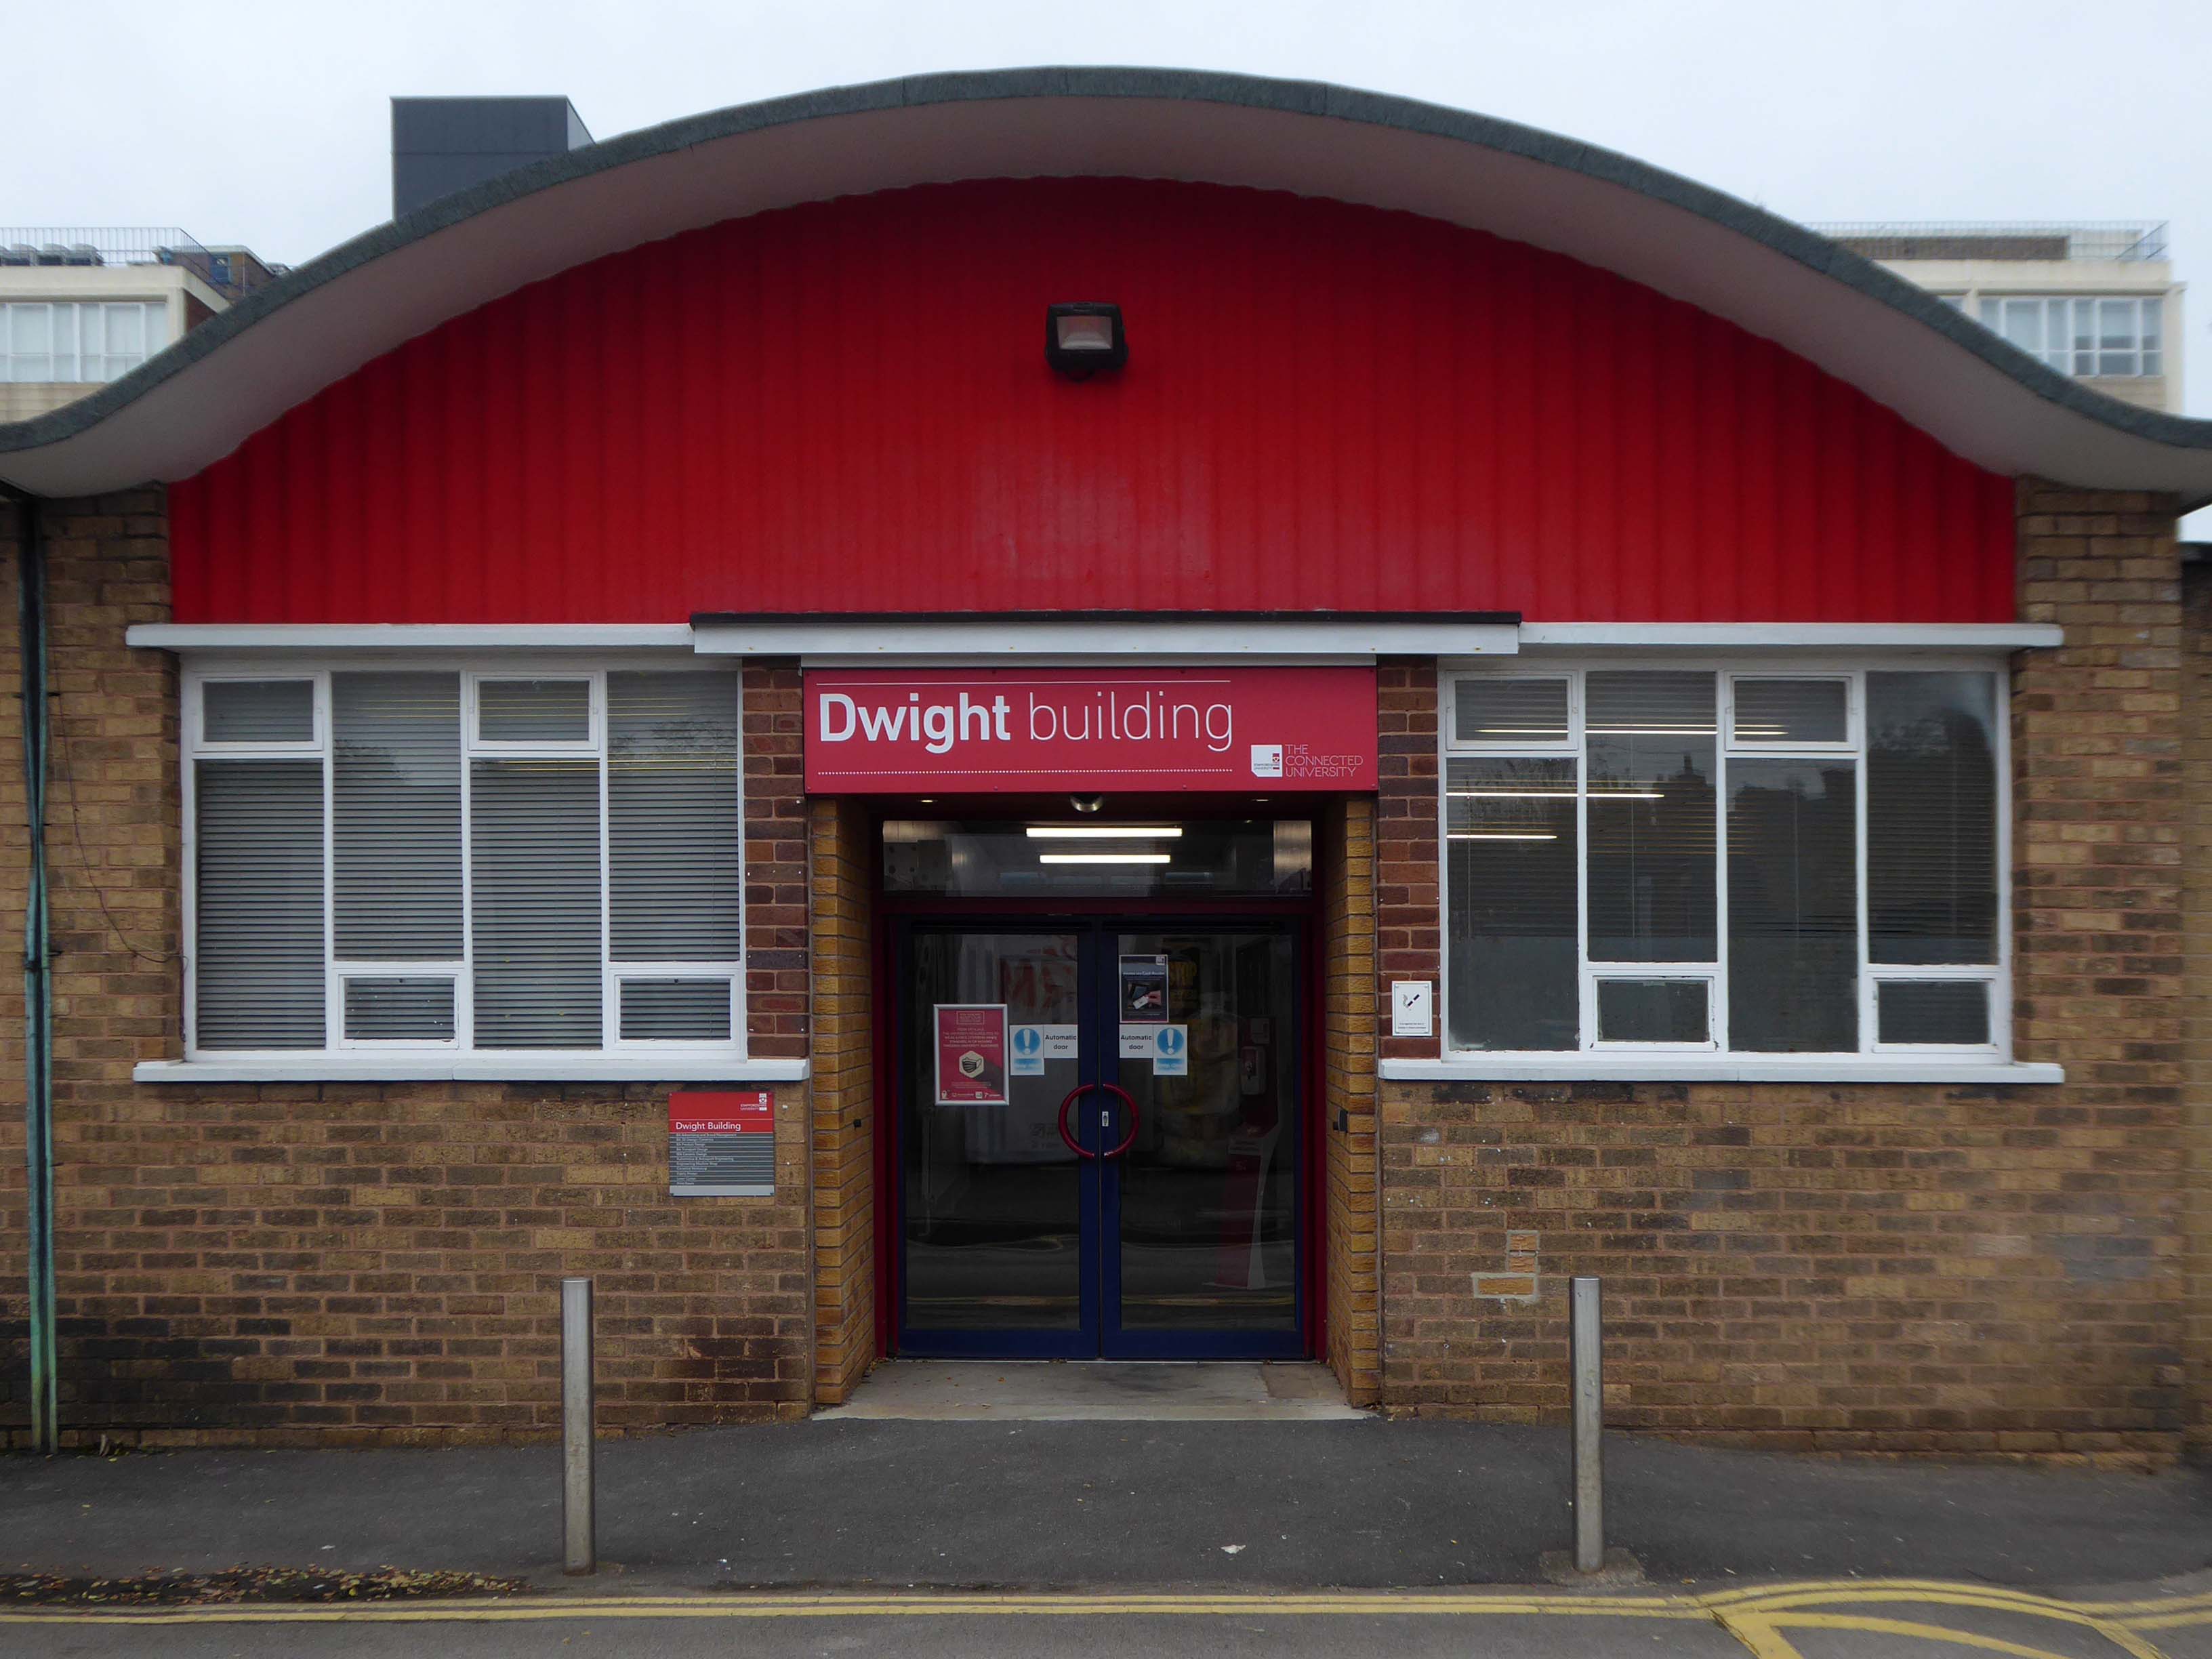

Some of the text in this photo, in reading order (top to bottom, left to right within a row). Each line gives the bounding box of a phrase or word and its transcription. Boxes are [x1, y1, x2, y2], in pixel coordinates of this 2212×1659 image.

[820, 691, 1231, 754] Dwight building
[1285, 744, 1309, 754] THE
[1285, 755, 1364, 766] CONNECTED
[1285, 766, 1356, 777] UNIVERSITY
[676, 1122, 741, 1132] Dwight Building
